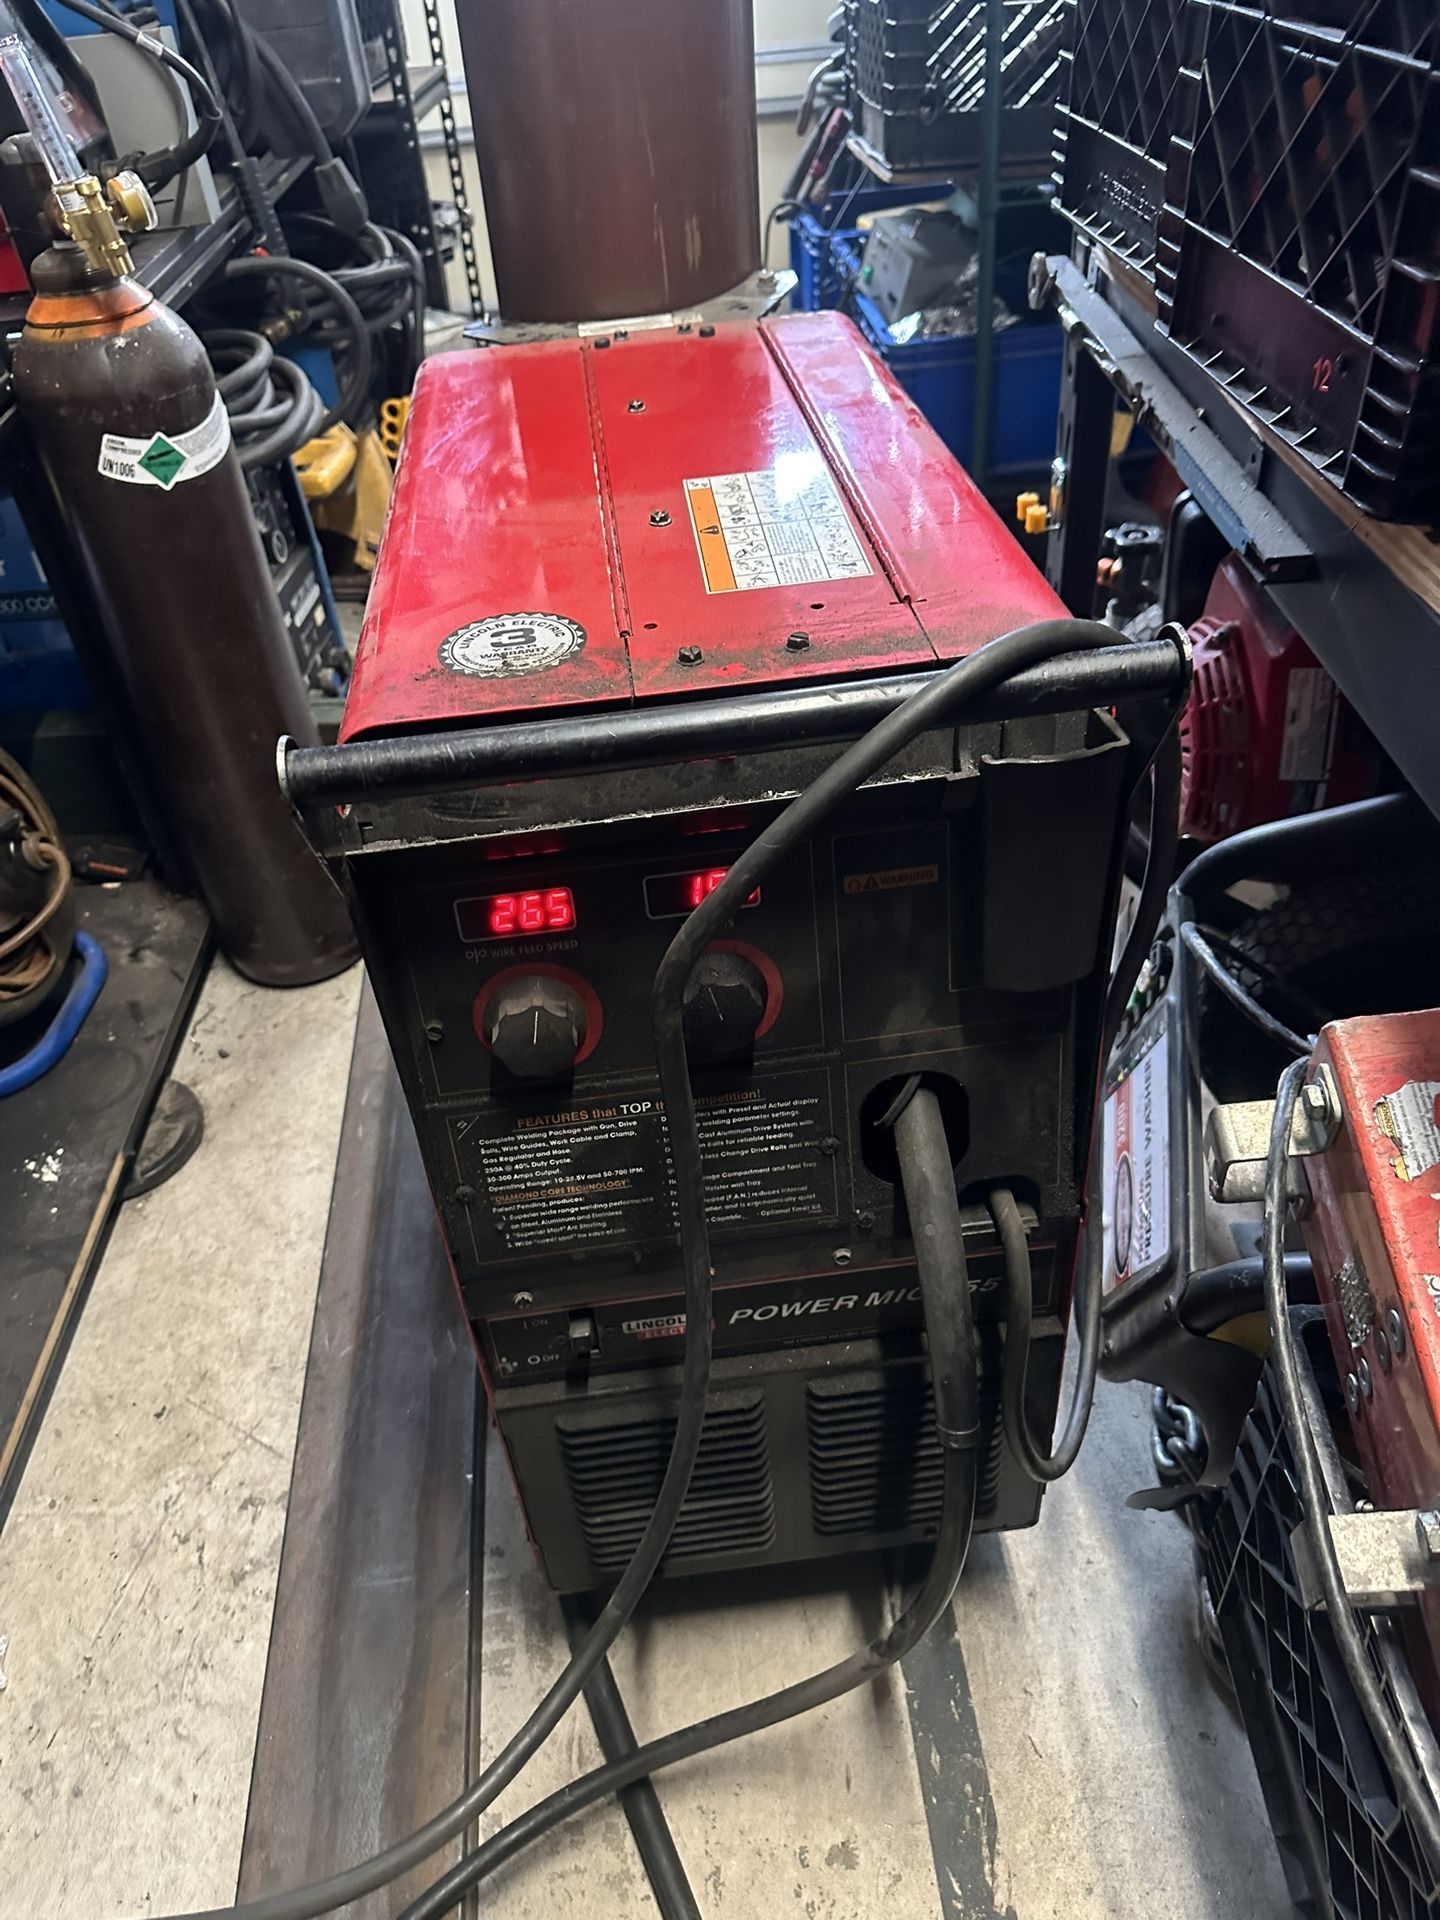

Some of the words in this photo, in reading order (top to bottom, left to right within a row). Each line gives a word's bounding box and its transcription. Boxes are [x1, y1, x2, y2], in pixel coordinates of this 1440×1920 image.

[1313, 358, 1332, 392] 12
[102, 457, 135, 478] UN1006
[459, 622, 506, 649] LINCOLN
[512, 619, 566, 638] ELECTRIC
[490, 627, 537, 648] 3
[480, 646, 549, 659] WARRANTY
[880, 870, 935, 885] WARNING
[493, 890, 571, 932] 265
[490, 947, 516, 958] WIRE
[519, 944, 544, 955] FEED
[546, 939, 578, 951] SPEED
[728, 1105, 751, 1114] Preset
[752, 1103, 767, 1111] and
[768, 1100, 791, 1109] Actual
[792, 1097, 819, 1107] display
[517, 1110, 589, 1128] FEATURES
[592, 1107, 617, 1118] that
[620, 1101, 652, 1115] TOP
[702, 1118, 731, 1127] welding
[732, 1114, 770, 1124] parameter
[1381, 1105, 1394, 1136] ARNING
[479, 1135, 515, 1145] Complete
[516, 1132, 547, 1141] Welding
[548, 1127, 581, 1137] Package
[583, 1123, 598, 1132] with
[618, 1120, 638, 1128] Drive
[698, 1130, 716, 1139] Cast
[716, 1127, 752, 1137] Aluminum
[753, 1124, 772, 1133] Drive
[772, 1121, 799, 1131] System
[501, 1144, 519, 1152] Wire
[549, 1138, 568, 1146] Work
[569, 1134, 593, 1143] Cable
[593, 1132, 609, 1140] and
[720, 1149, 750, 1158] Change
[750, 1146, 769, 1154] Drive
[770, 1143, 787, 1151] Rolls
[482, 1157, 498, 1165] Gas
[499, 1152, 535, 1162] Regulator
[535, 1150, 551, 1158] and
[531, 1160, 548, 1169] Duty
[513, 1172, 533, 1181] Amps
[771, 1164, 786, 1172] and
[488, 1183, 525, 1193] Operating
[586, 1172, 601, 1180] and
[540, 1188, 565, 1197] CORE
[540, 1208, 557, 1216] wide
[558, 1206, 579, 1214] range
[579, 1202, 608, 1211] welding
[576, 1213, 591, 1221] and
[728, 1294, 858, 1325] POWER
[968, 1276, 1002, 1294] 55
[626, 1316, 686, 1332] LINCOL
[645, 1327, 686, 1339] ELECT
